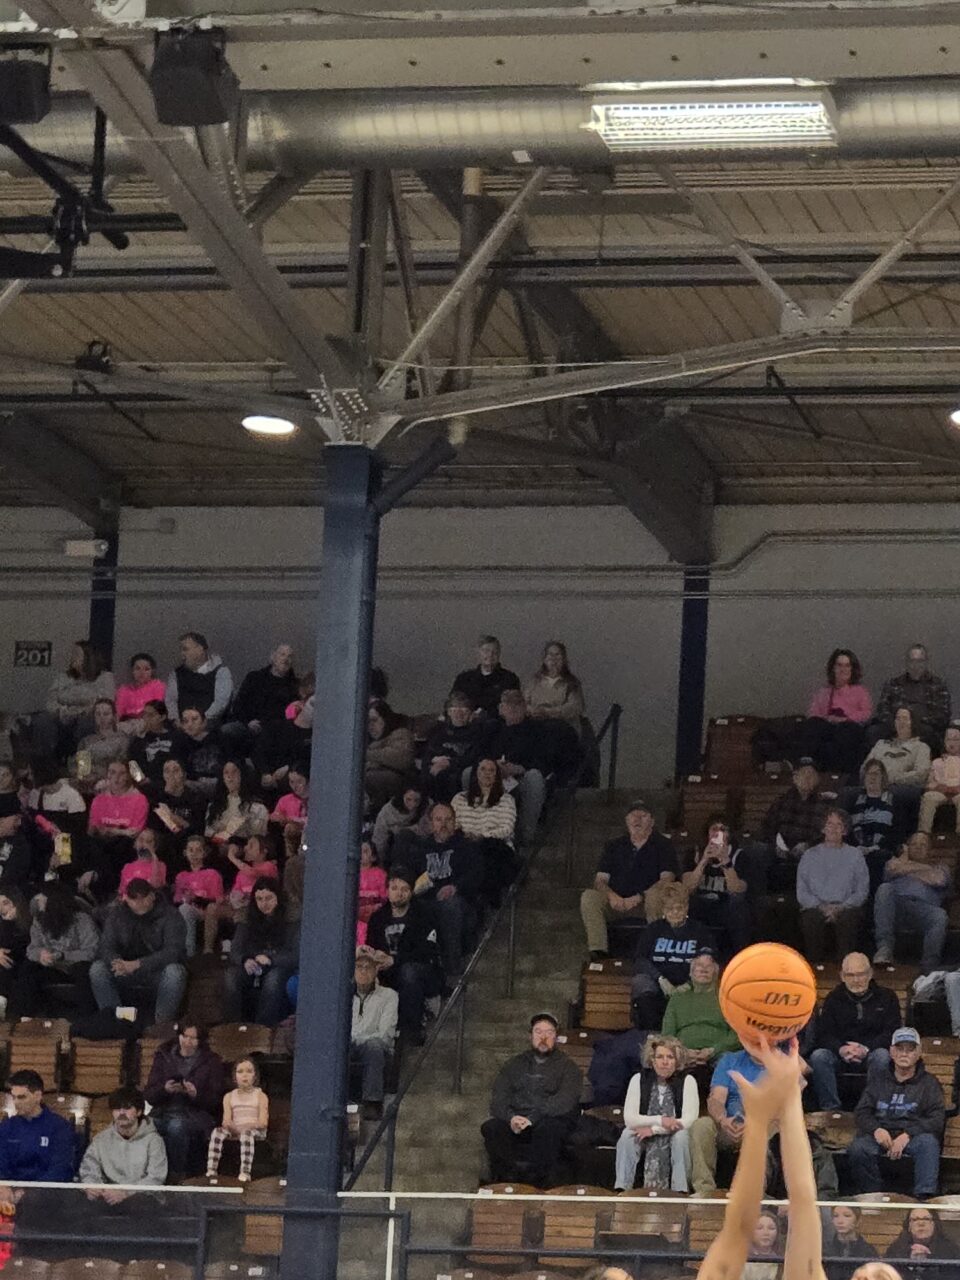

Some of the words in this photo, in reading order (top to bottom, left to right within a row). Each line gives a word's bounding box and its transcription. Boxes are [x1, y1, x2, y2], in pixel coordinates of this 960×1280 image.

[17, 650, 49, 665] 201
[654, 937, 697, 954] BLUE
[763, 991, 802, 1007] EVO
